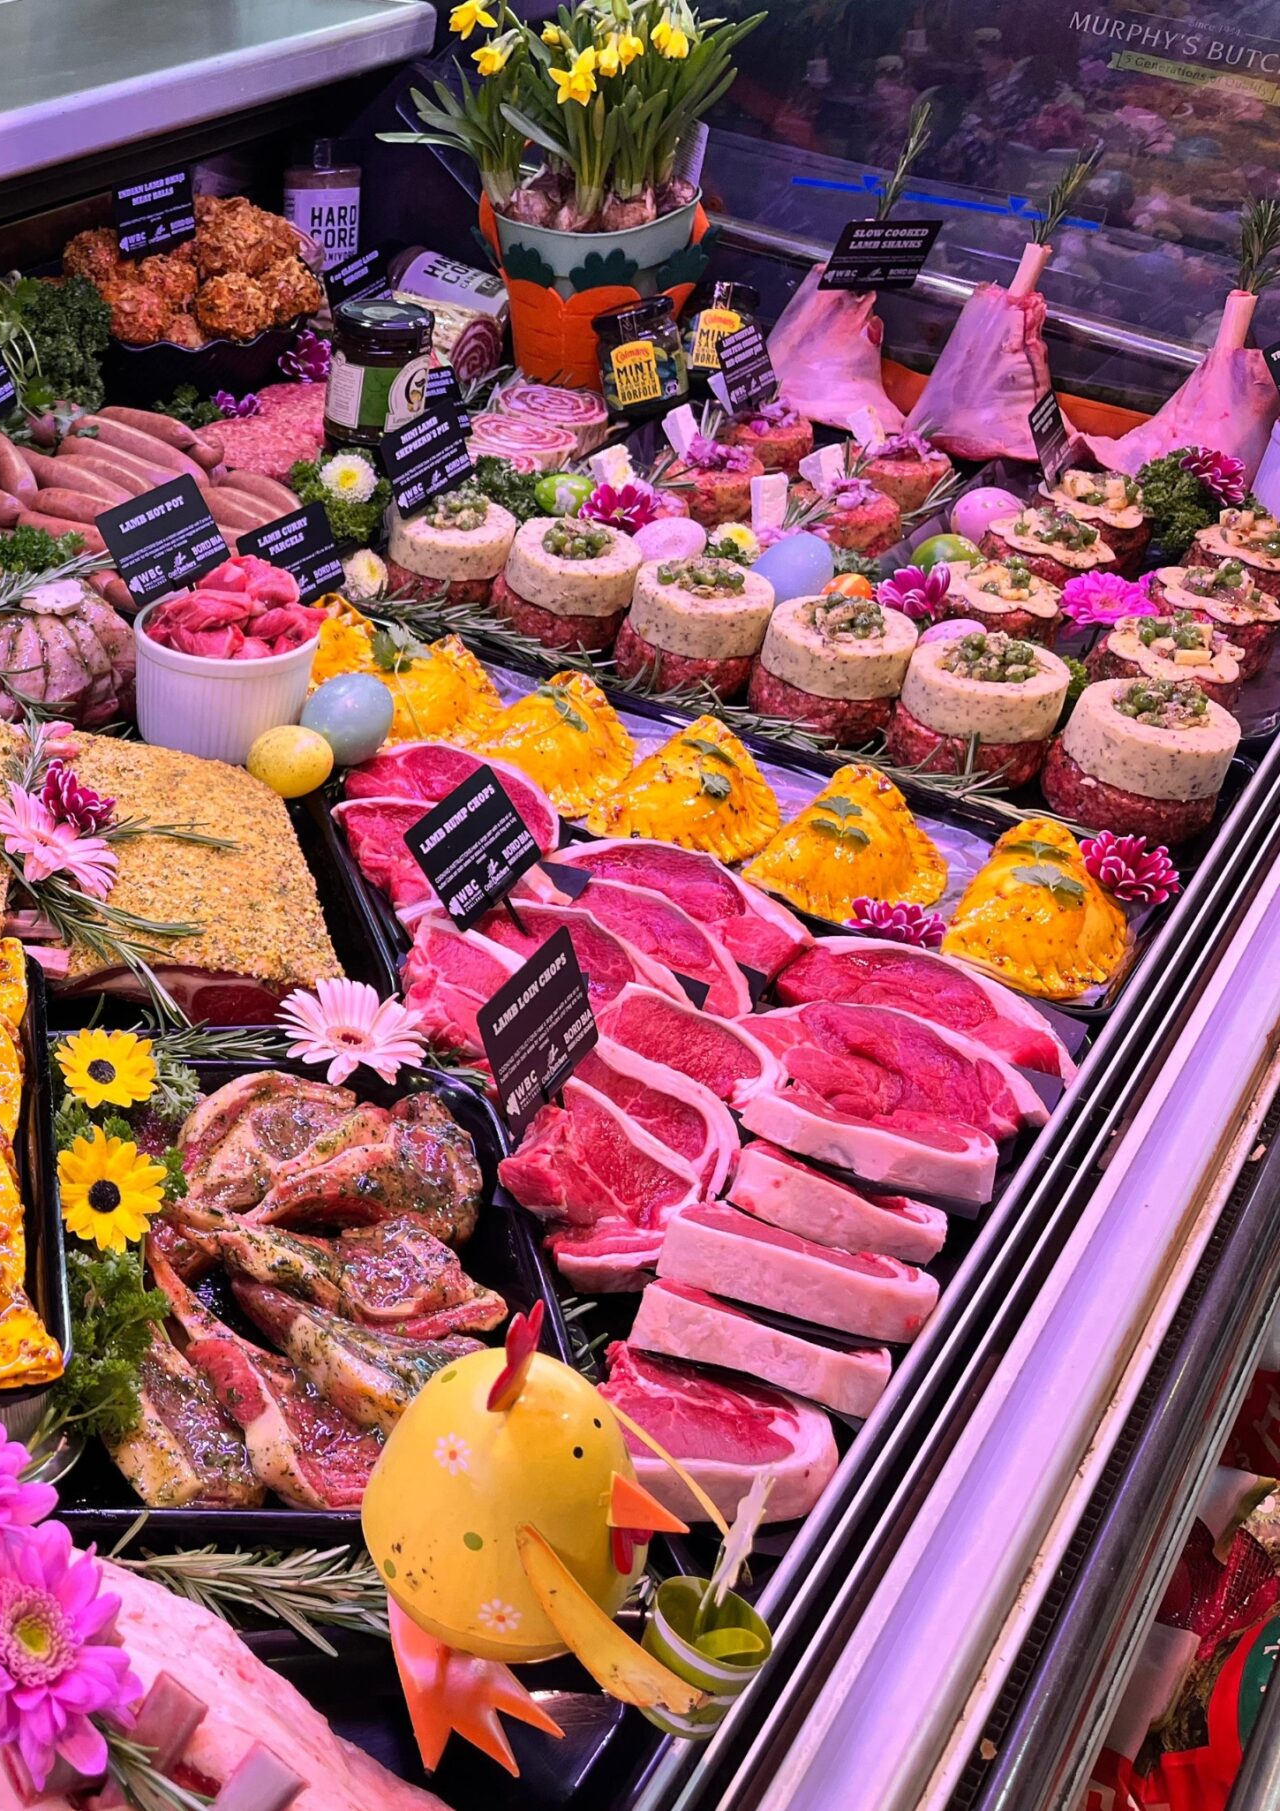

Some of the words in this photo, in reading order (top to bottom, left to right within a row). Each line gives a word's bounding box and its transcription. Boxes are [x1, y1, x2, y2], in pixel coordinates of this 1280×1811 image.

[1069, 11, 1199, 56] MURPHY'S
[1208, 40, 1280, 75] BUTC
[1135, 57, 1206, 82] Generations
[144, 179, 164, 192] LAMB
[311, 205, 357, 227] HARD
[849, 240, 881, 249] LAMB
[881, 240, 923, 249] SHANKS
[853, 229, 884, 237] SLOW
[884, 228, 929, 237] COOKED
[616, 360, 652, 380] MINT
[620, 384, 659, 402] NORFOLK
[395, 429, 437, 460] SHEPHERD'S
[436, 422, 449, 435] PIE
[400, 427, 418, 444] MINI
[417, 416, 438, 434] LAMB
[404, 483, 423, 501] WBC
[119, 514, 147, 533] LAMB
[145, 504, 166, 521] HOT
[164, 495, 184, 511] POT
[257, 530, 282, 547] LAMB
[281, 517, 307, 536] CURRY
[269, 532, 304, 556] PARCELS
[191, 540, 212, 556] BORD
[209, 535, 223, 546] BIA
[138, 565, 163, 583] WBC
[313, 564, 331, 578] BORD
[419, 828, 446, 854] LAMB
[443, 807, 468, 833] RUMP
[467, 784, 495, 812] CHOPS
[502, 839, 521, 859] BORD
[517, 830, 531, 845] BIA
[456, 879, 479, 903] WBC
[492, 1003, 519, 1036] LAMB
[517, 980, 539, 1010] LOIN
[539, 952, 566, 987] CHOPS
[563, 1019, 582, 1044] BORD
[580, 1008, 592, 1026] BIA
[515, 1070, 538, 1100] WBC
